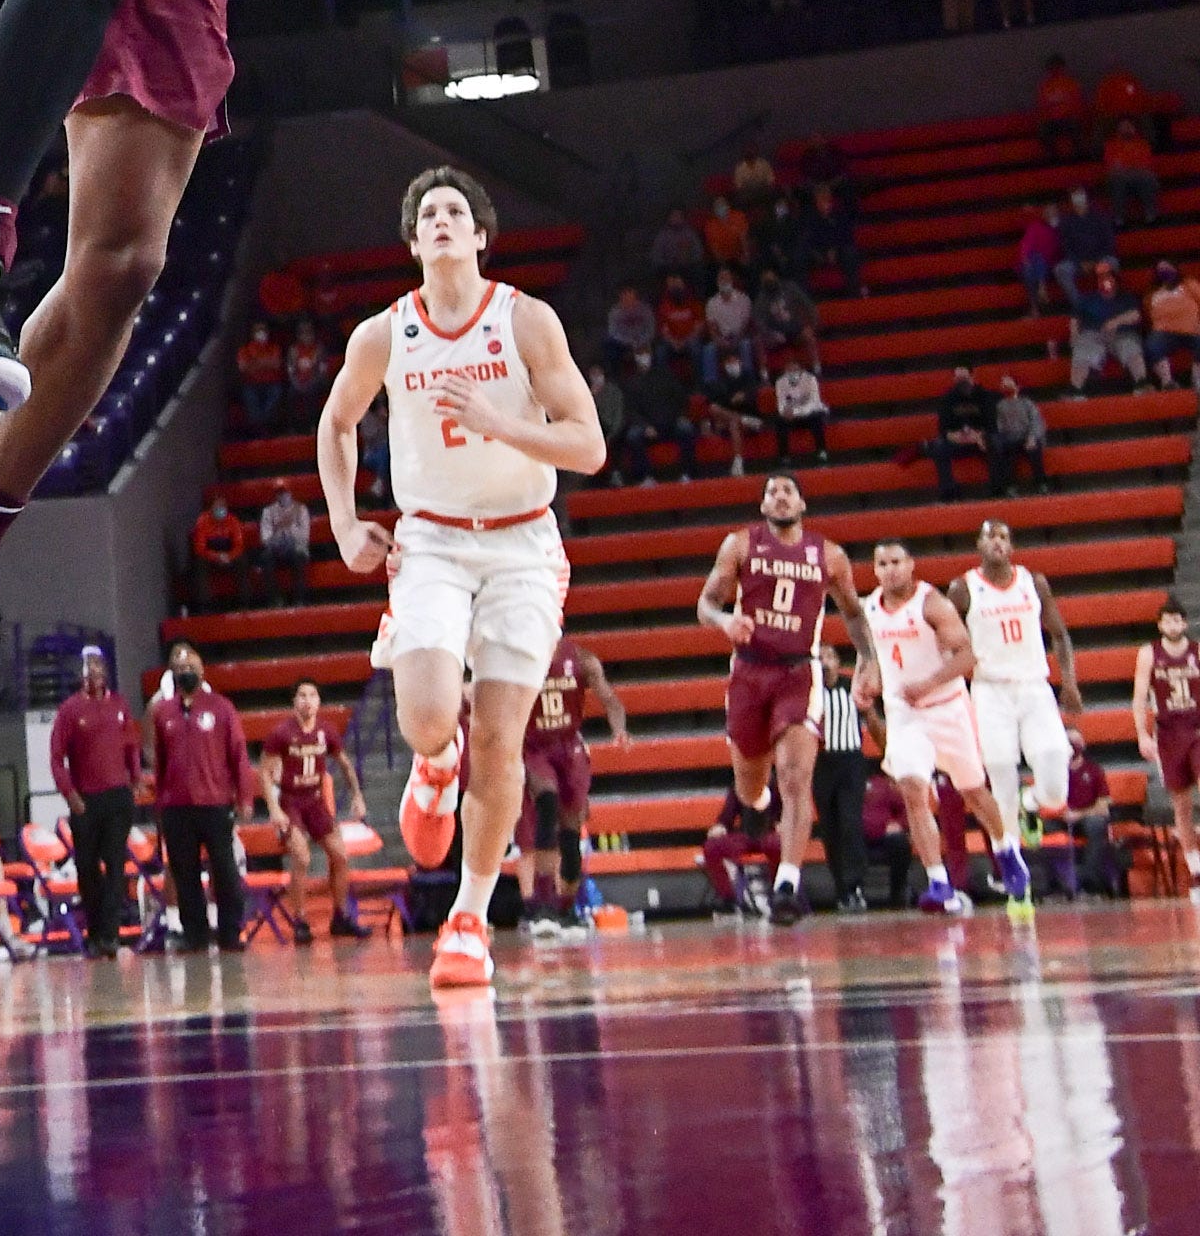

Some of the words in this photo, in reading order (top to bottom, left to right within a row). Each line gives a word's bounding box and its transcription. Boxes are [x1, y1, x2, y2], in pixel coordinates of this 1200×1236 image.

[750, 557, 822, 583] FLORIDA
[772, 578, 795, 613] 0
[1000, 618, 1023, 645] 10
